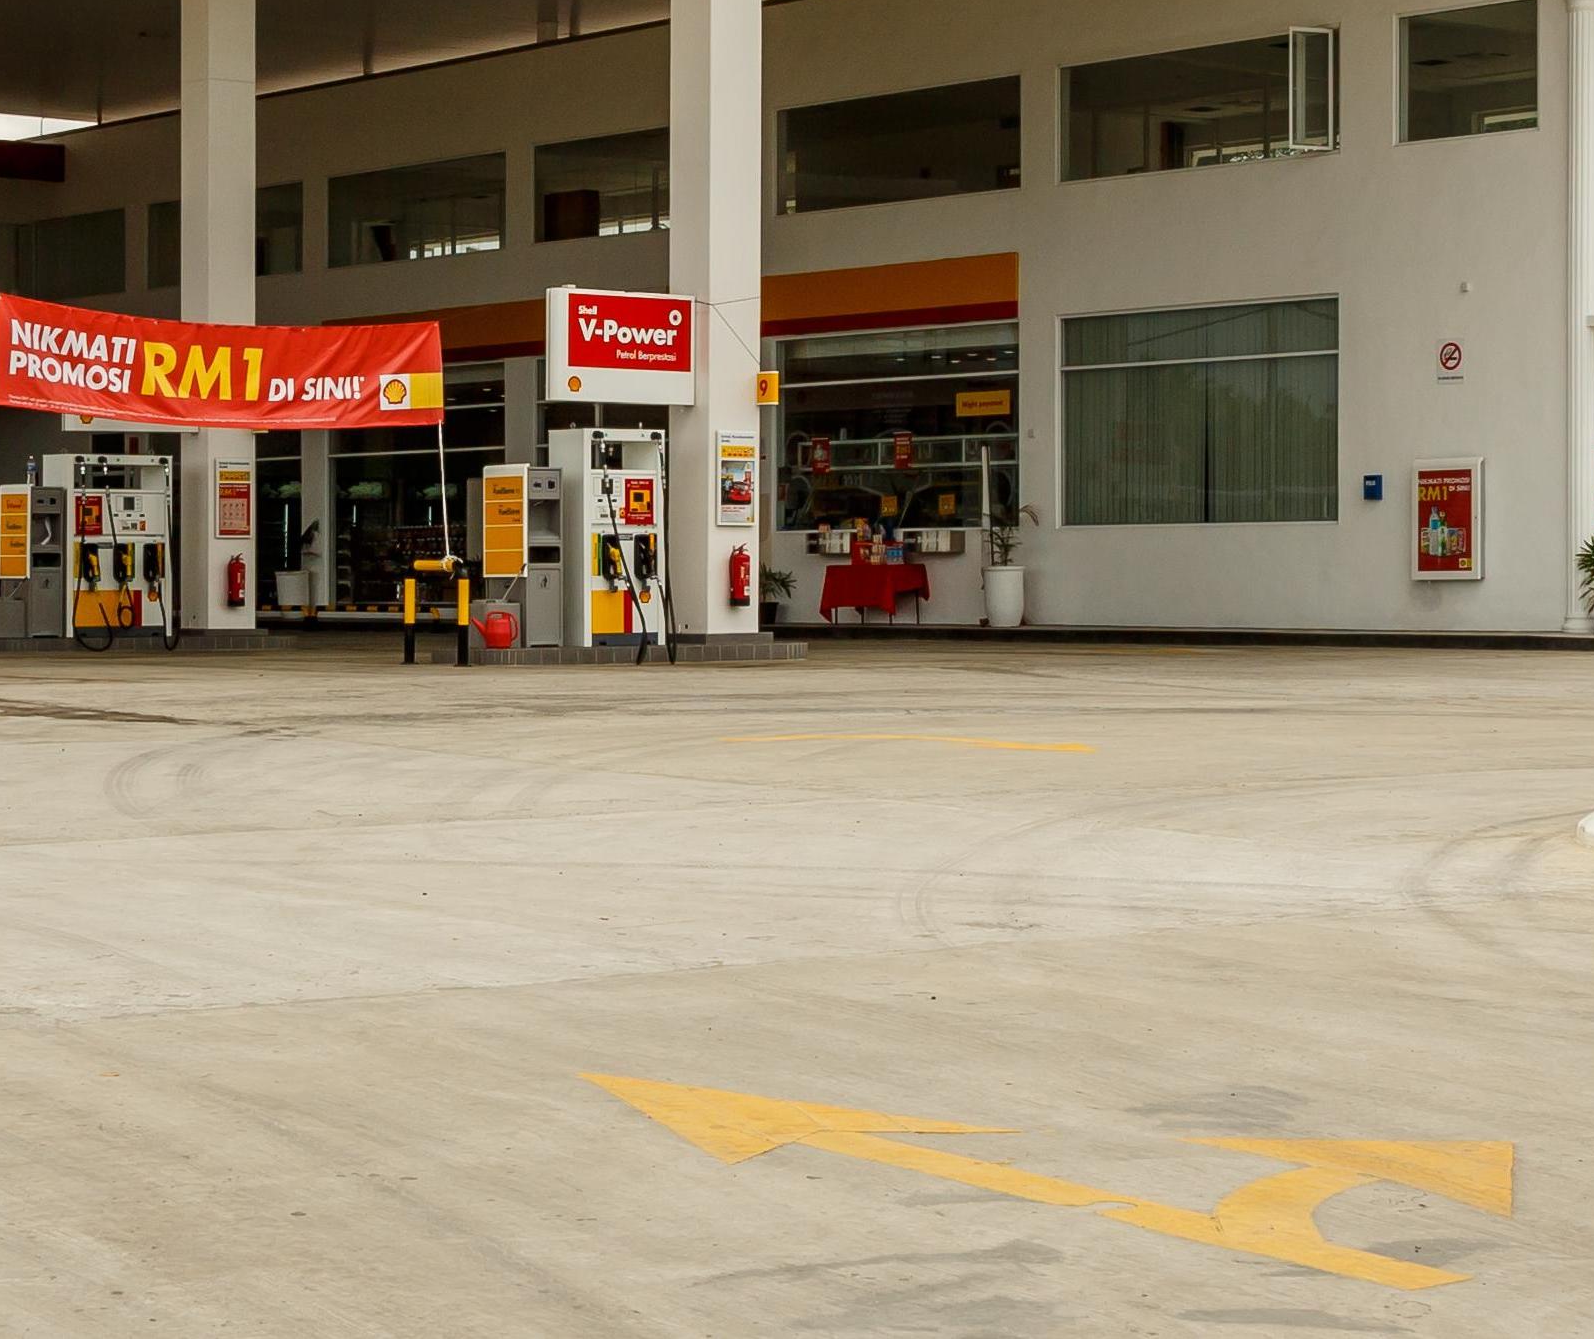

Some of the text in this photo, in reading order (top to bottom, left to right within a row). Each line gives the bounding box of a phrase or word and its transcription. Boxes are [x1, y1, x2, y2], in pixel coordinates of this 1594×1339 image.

[578, 304, 597, 315] Shell
[11, 318, 137, 365] NIKMATI
[578, 318, 677, 346] V-Power
[616, 349, 677, 364] Petrol Berprestasi
[9, 350, 132, 394] PROMOSI
[140, 340, 264, 402] RM1
[268, 377, 295, 402] DI
[759, 379, 768, 396] 9
